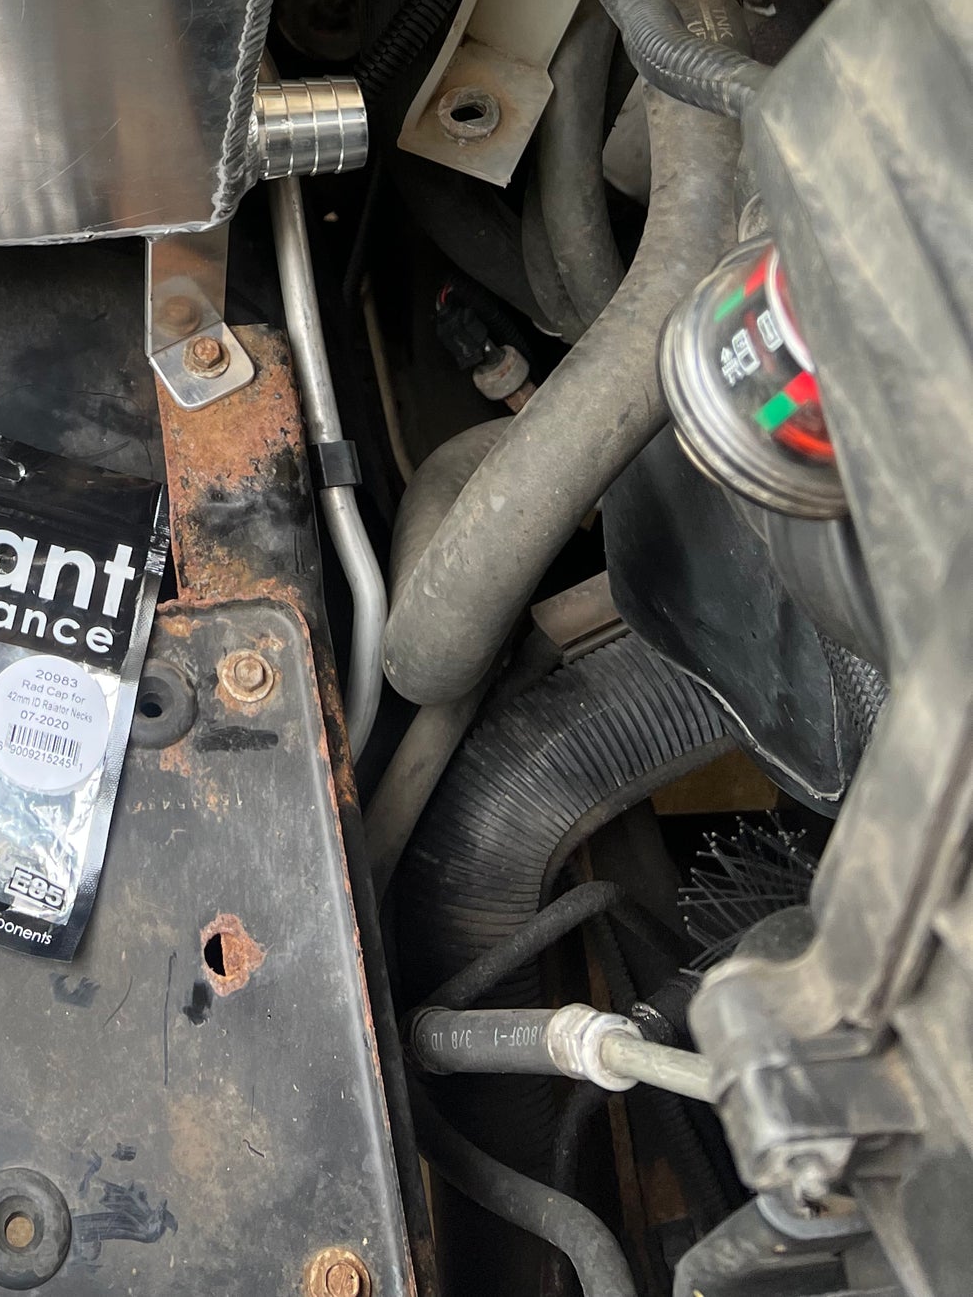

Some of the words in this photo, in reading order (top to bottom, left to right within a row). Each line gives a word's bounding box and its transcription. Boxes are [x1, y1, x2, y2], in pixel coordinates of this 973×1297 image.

[35, 669, 78, 688] 20983
[22, 679, 44, 694] Rad
[47, 686, 68, 701] Cap
[71, 692, 86, 705] for
[7, 691, 30, 705] 42mm
[32, 697, 41, 708] ID
[71, 708, 93, 723] Necks
[20, 709, 69, 731] 07-2020
[9, 743, 72, 769] 9009215245
[451, 1029, 473, 1050] 3/8
